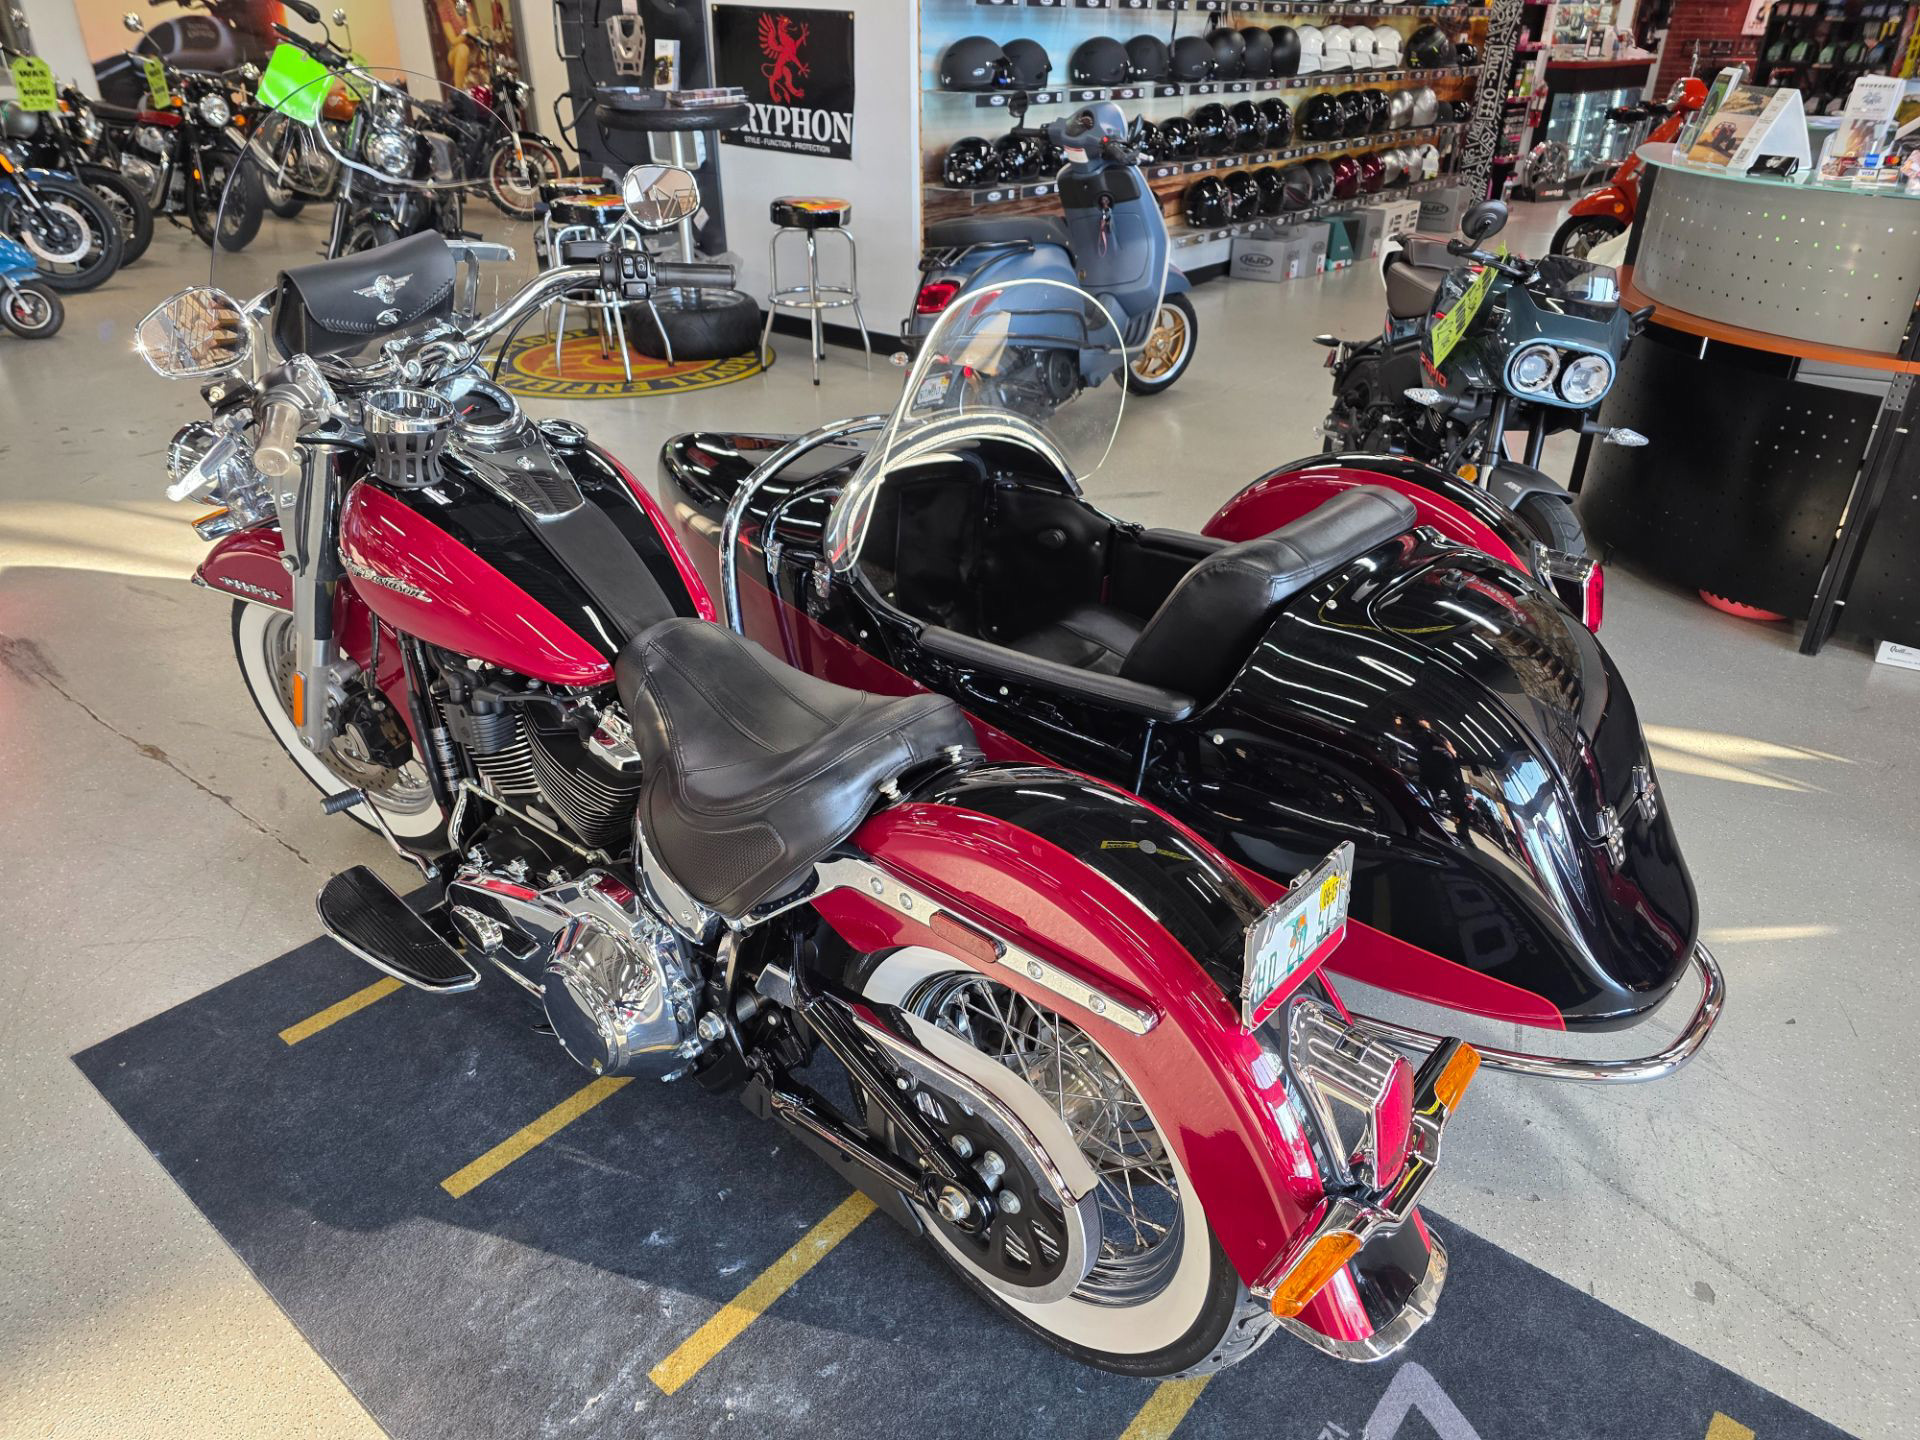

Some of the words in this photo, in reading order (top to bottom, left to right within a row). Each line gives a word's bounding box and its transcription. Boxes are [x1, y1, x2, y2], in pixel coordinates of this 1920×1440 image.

[1478, 49, 1504, 120] Muc-Off
[730, 102, 853, 144] RYPHON
[660, 351, 758, 387] ROYAL
